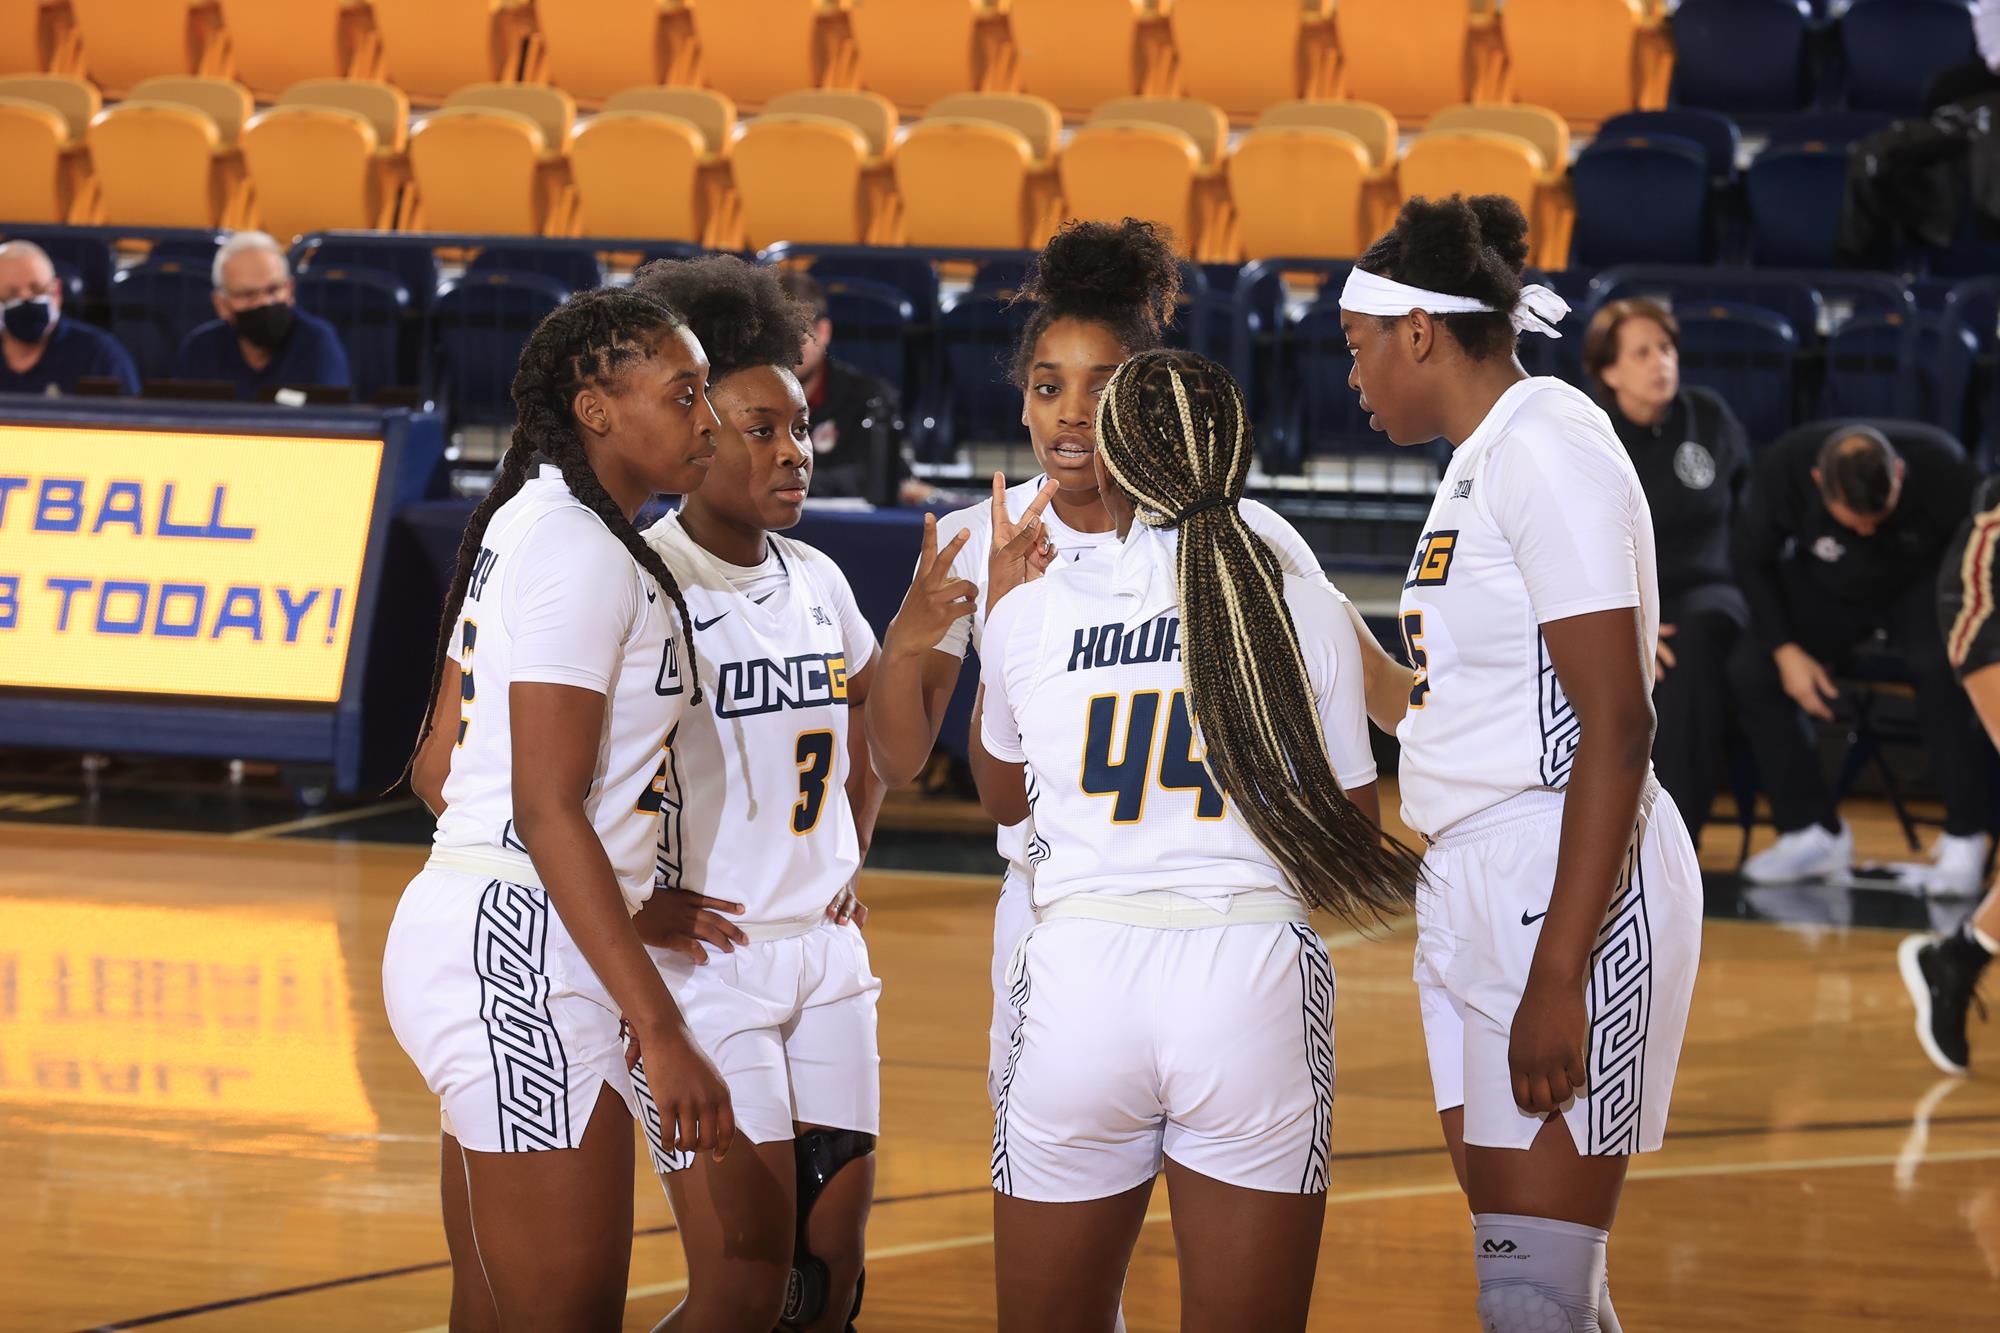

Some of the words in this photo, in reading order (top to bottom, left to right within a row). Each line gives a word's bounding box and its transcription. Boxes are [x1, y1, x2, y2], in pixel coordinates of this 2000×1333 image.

[46, 578, 342, 645] TODAY!
[715, 652, 847, 719] UNCG
[789, 727, 836, 837] 3
